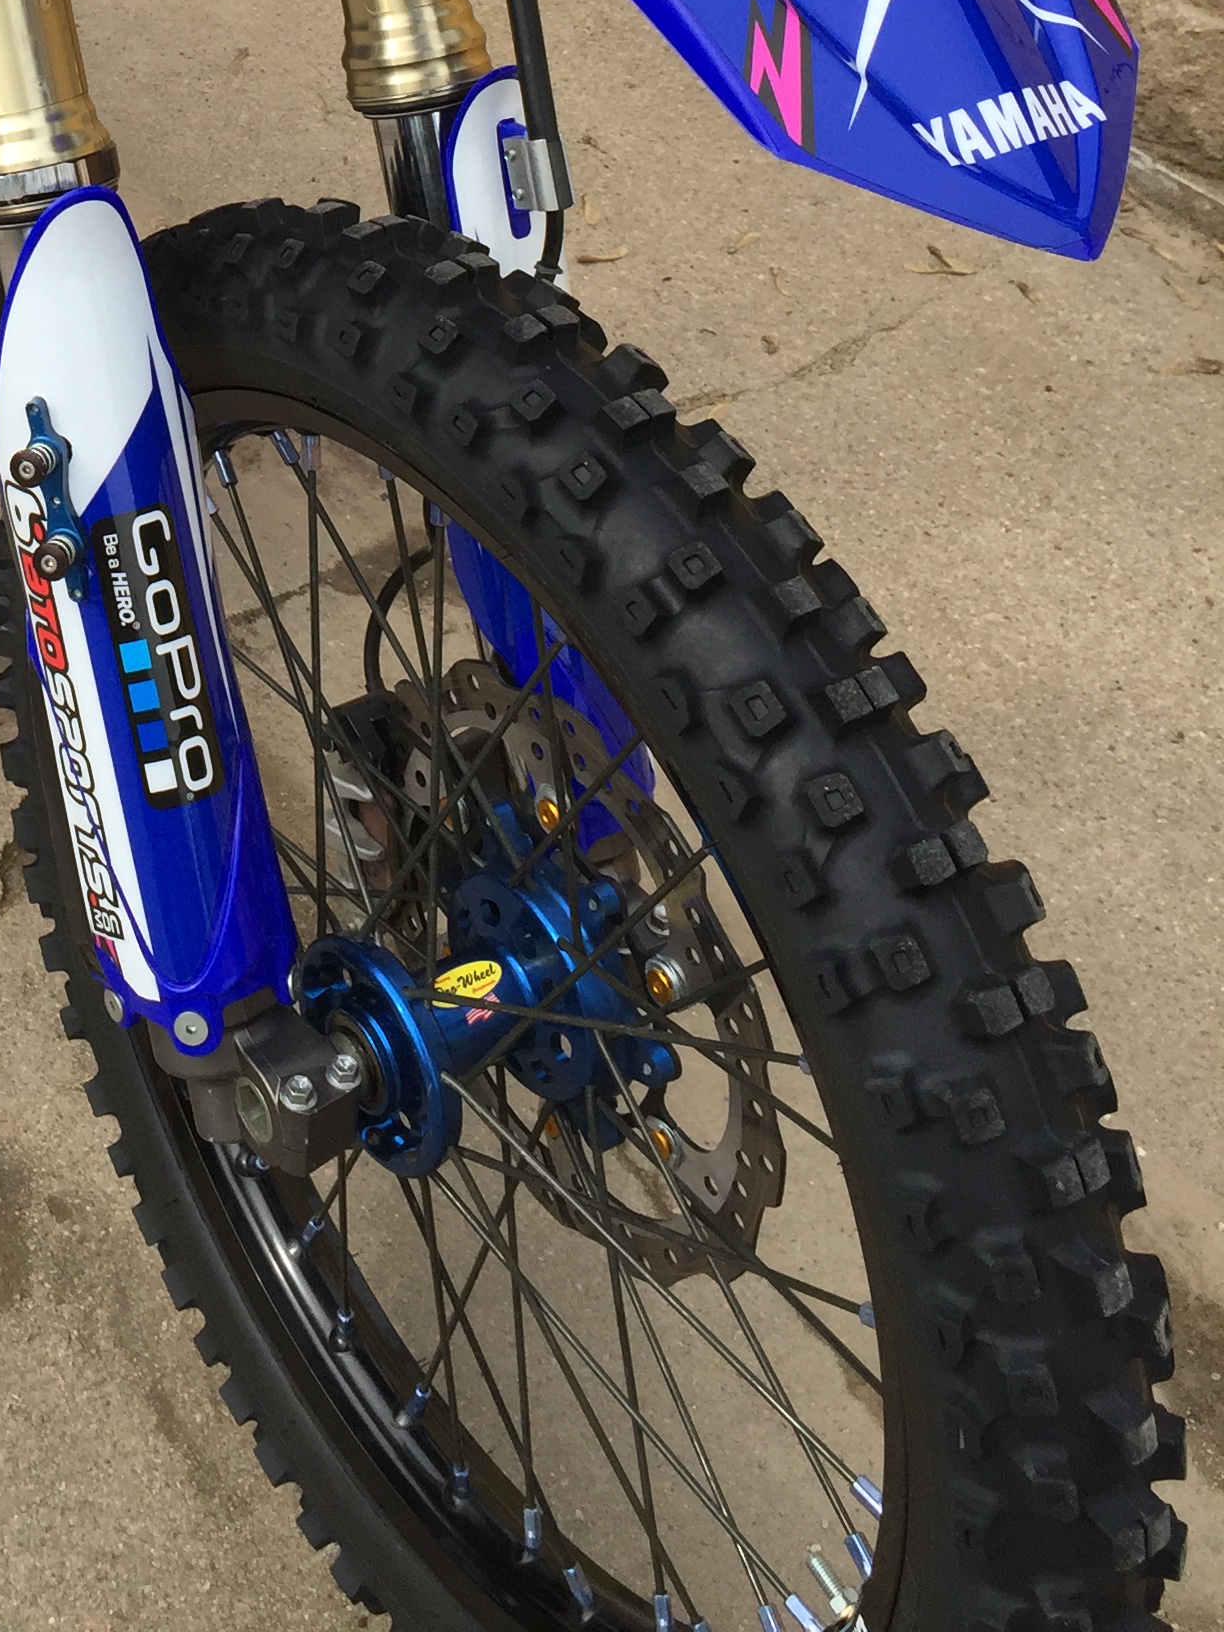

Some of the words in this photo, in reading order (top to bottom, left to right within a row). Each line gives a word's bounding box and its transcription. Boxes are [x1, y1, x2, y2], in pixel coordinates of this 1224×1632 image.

[911, 80, 1108, 167] YAMAHA
[102, 533, 119, 558] Be
[106, 559, 120, 571] a
